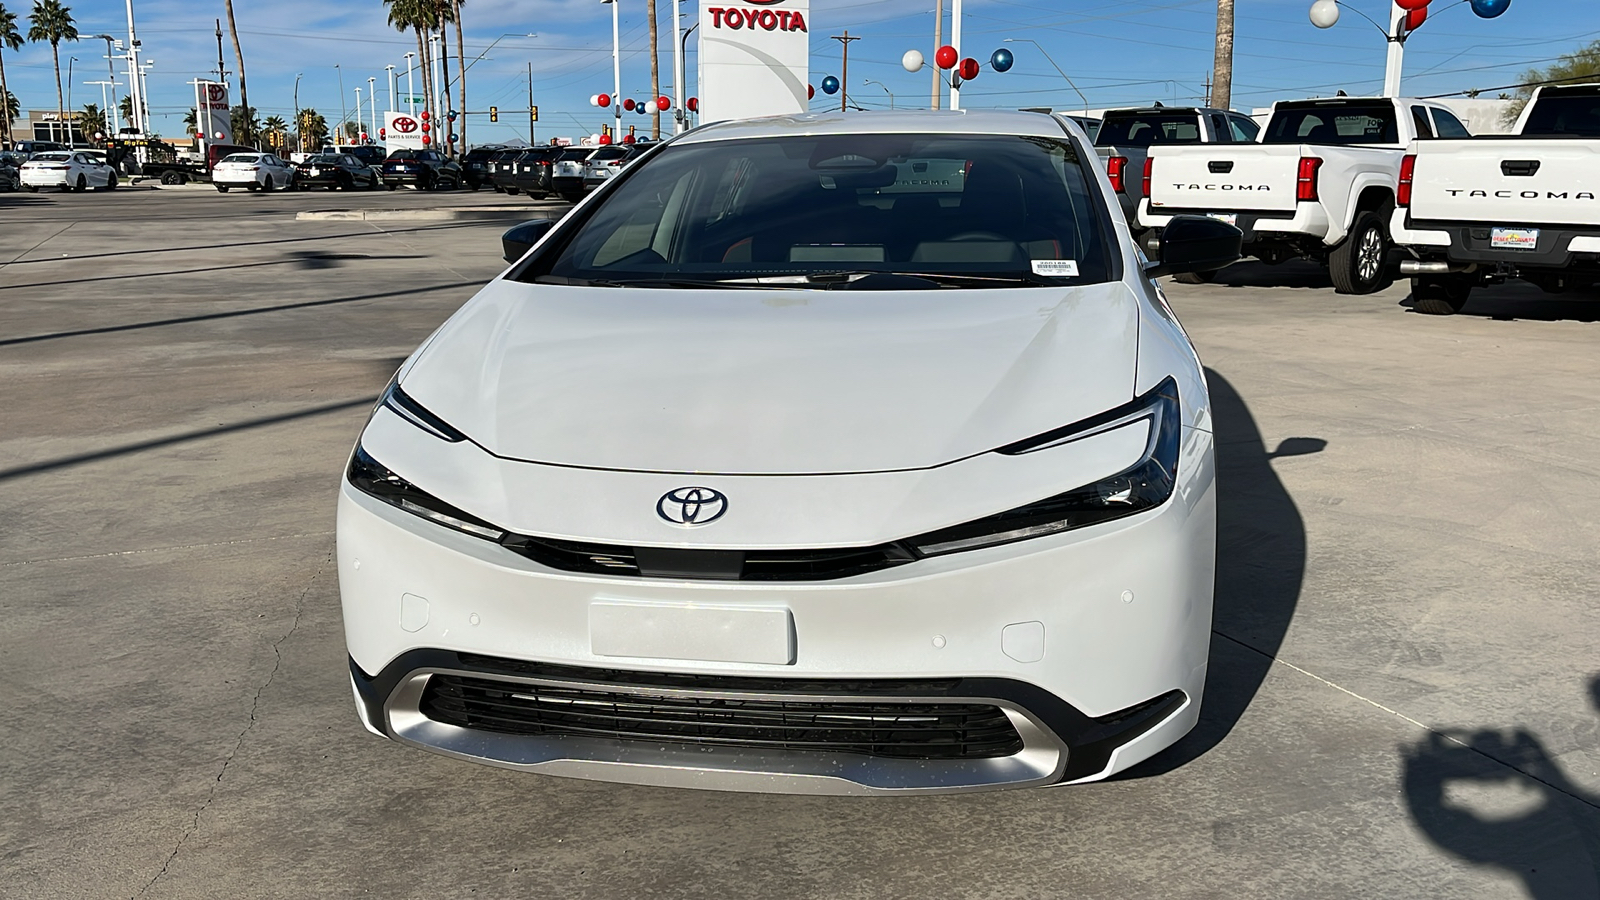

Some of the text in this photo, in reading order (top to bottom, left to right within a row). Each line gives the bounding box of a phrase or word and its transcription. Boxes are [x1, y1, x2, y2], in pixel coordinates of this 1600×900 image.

[708, 7, 808, 33] TOYOTA
[200, 102, 229, 111] TYOTA
[1172, 183, 1270, 191] TACOMA
[1445, 189, 1594, 200] TACOMA
